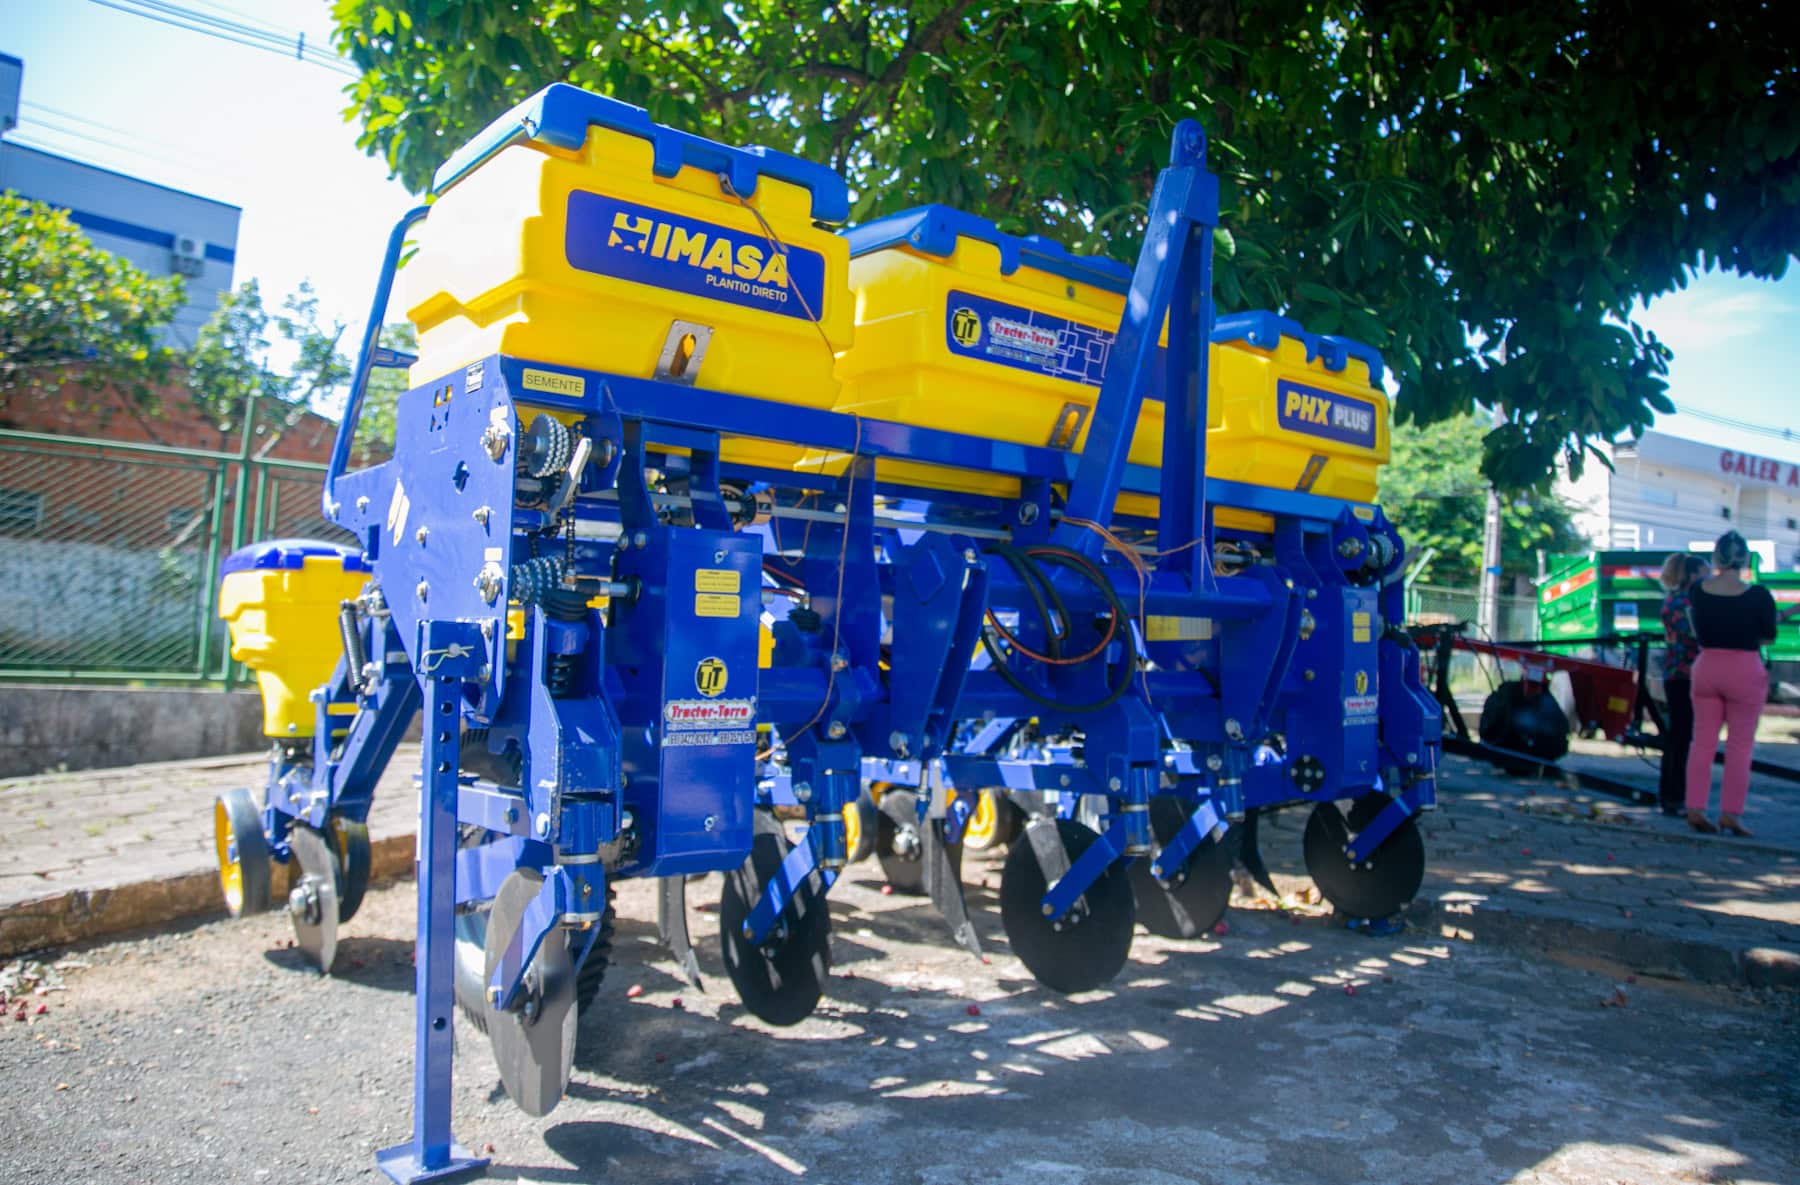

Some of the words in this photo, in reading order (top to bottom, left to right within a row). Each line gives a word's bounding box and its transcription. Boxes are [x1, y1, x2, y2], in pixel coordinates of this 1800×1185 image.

[706, 274, 751, 294] PLANTIO
[751, 285, 788, 303] DIRETO
[525, 374, 582, 393] SEMENTE
[1284, 390, 1332, 426] PHX
[1334, 402, 1372, 433] PLUS
